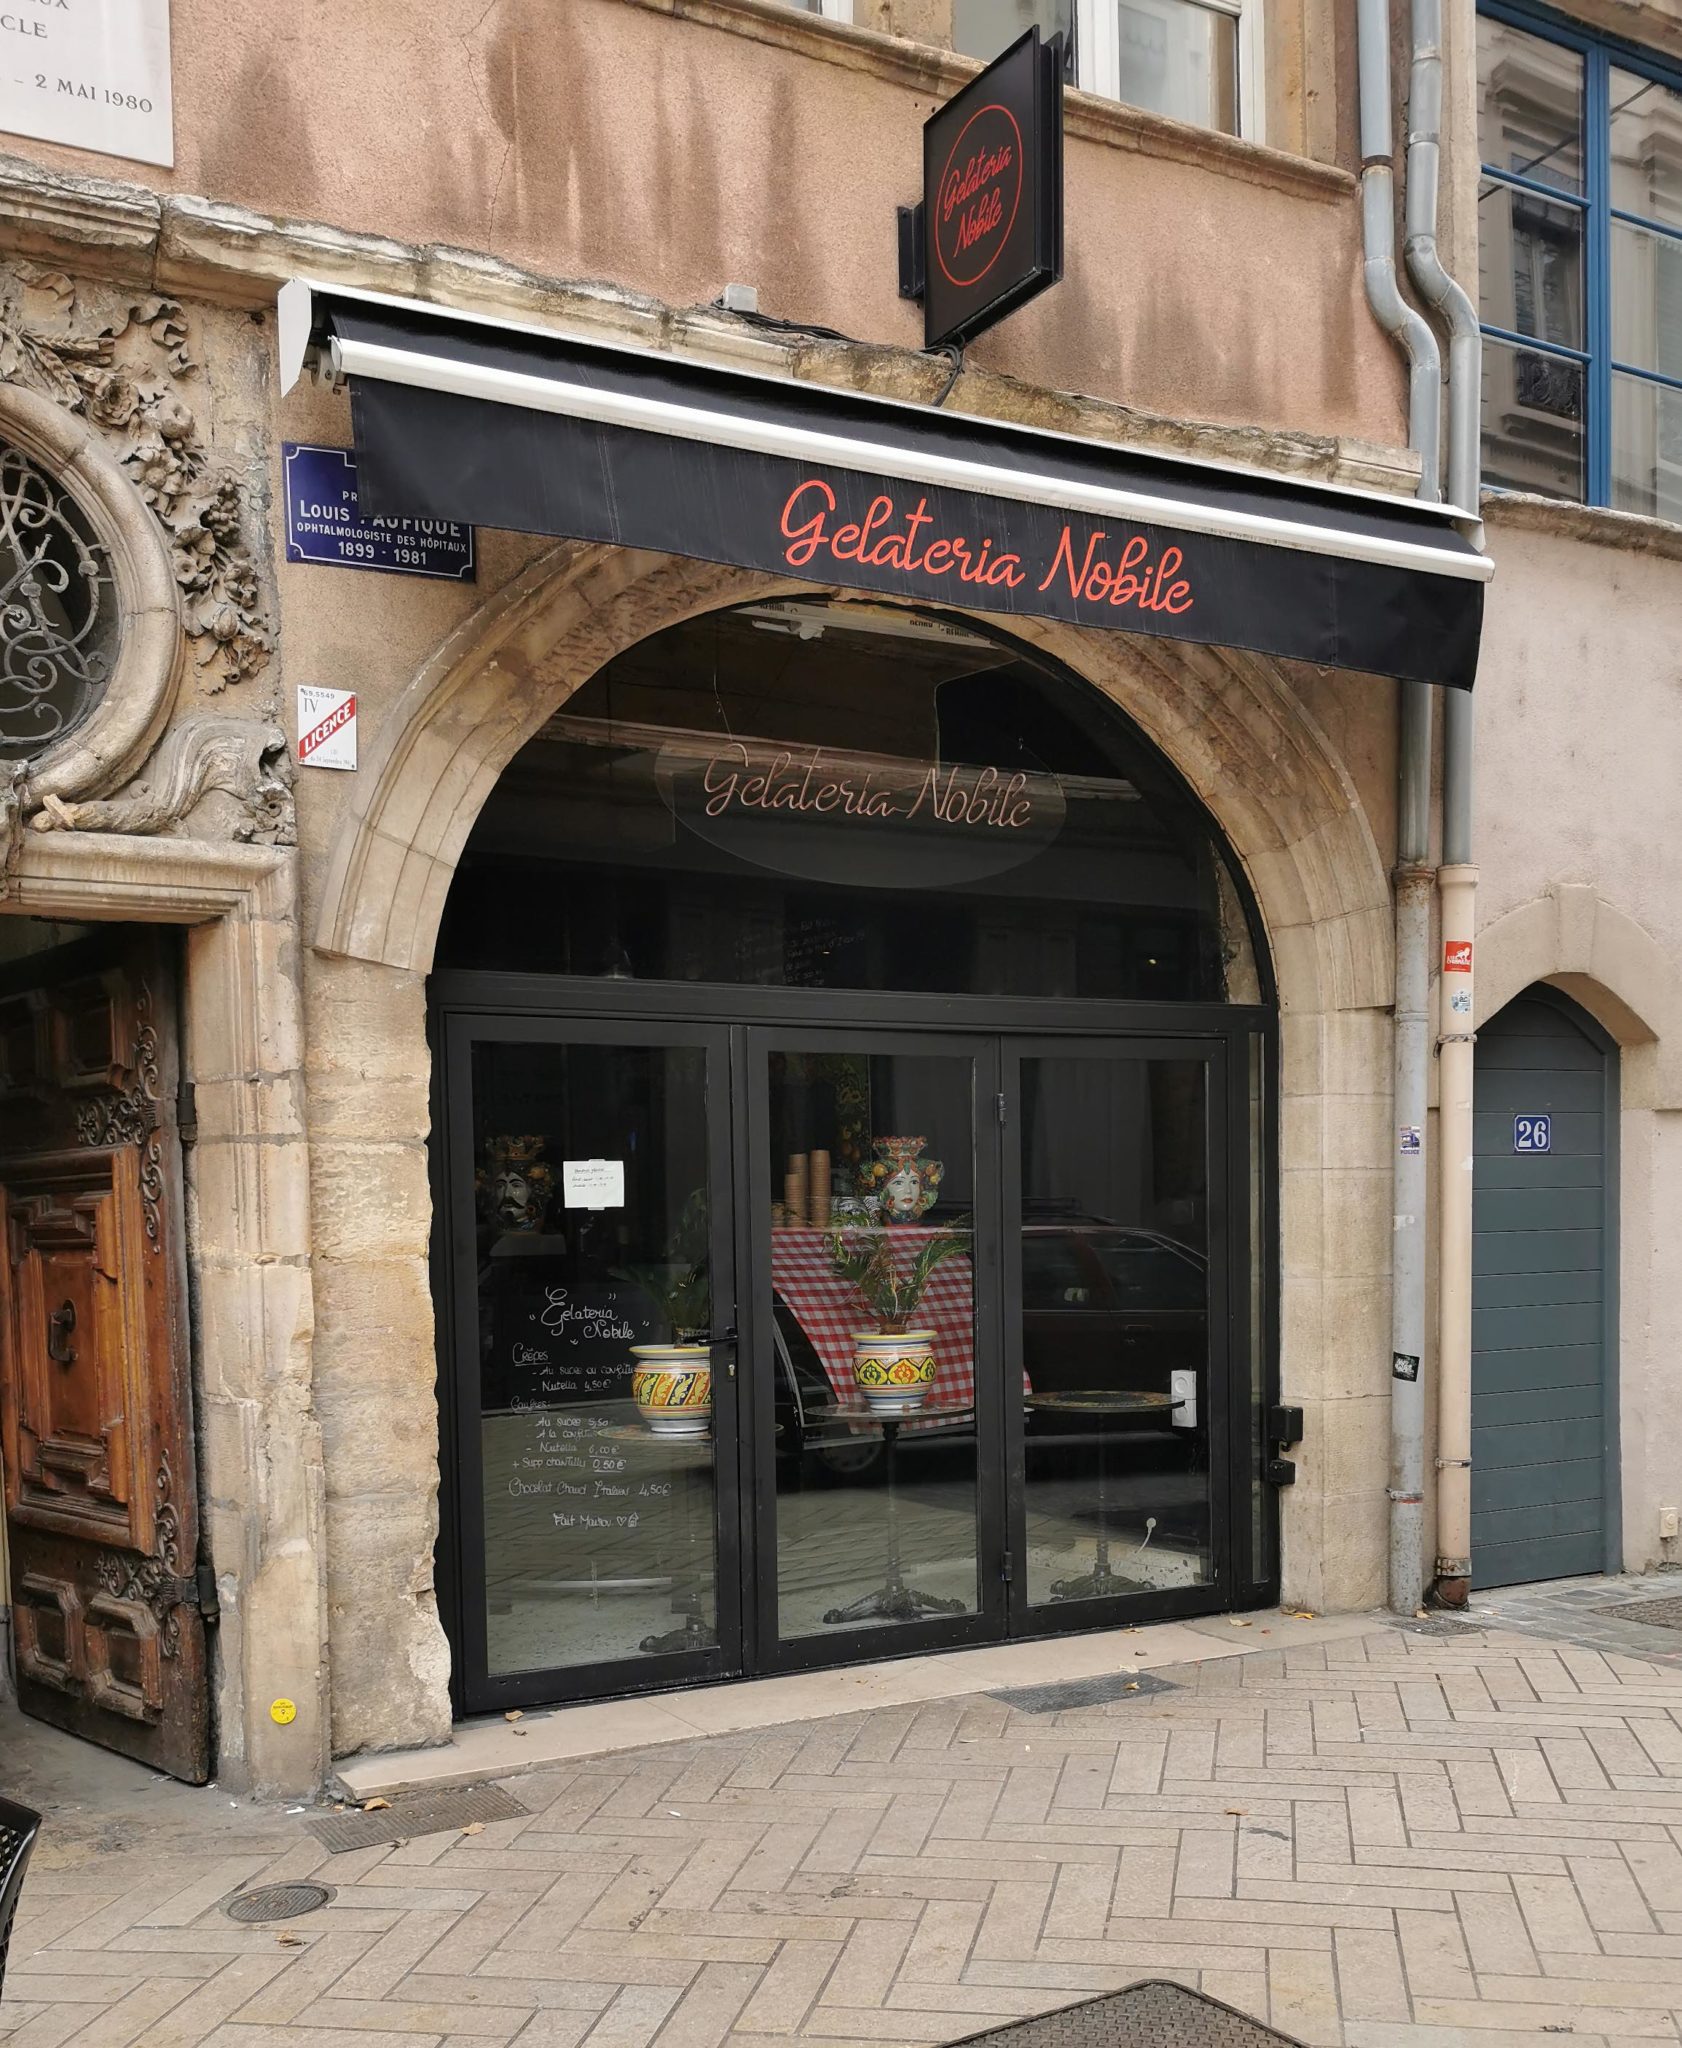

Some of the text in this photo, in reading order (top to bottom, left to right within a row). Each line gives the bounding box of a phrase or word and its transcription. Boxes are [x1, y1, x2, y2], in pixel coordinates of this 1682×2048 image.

[35, 74, 47, 88] 2
[57, 78, 96, 100] MAI
[105, 90, 153, 113] 1980
[943, 145, 1013, 222] Gelateria
[953, 187, 1003, 258] Nobile
[300, 500, 461, 537] LOUIS AUFIQUE
[297, 522, 467, 553] OPHTALMOLOGISTE DES HÔPITAUX
[338, 541, 375, 559] 1899
[394, 549, 427, 565] 1981
[780, 480, 1194, 614] Gelateria Nobile
[304, 698, 319, 713] IV
[304, 702, 352, 753] LICENCE
[703, 743, 1031, 828] Gelateria Nobile
[1518, 1120, 1547, 1147] 26
[542, 1380, 577, 1392] Nutella
[540, 1441, 577, 1452] Nutella
[508, 1476, 552, 1497] Chocolat
[553, 1512, 576, 1527] Fait
